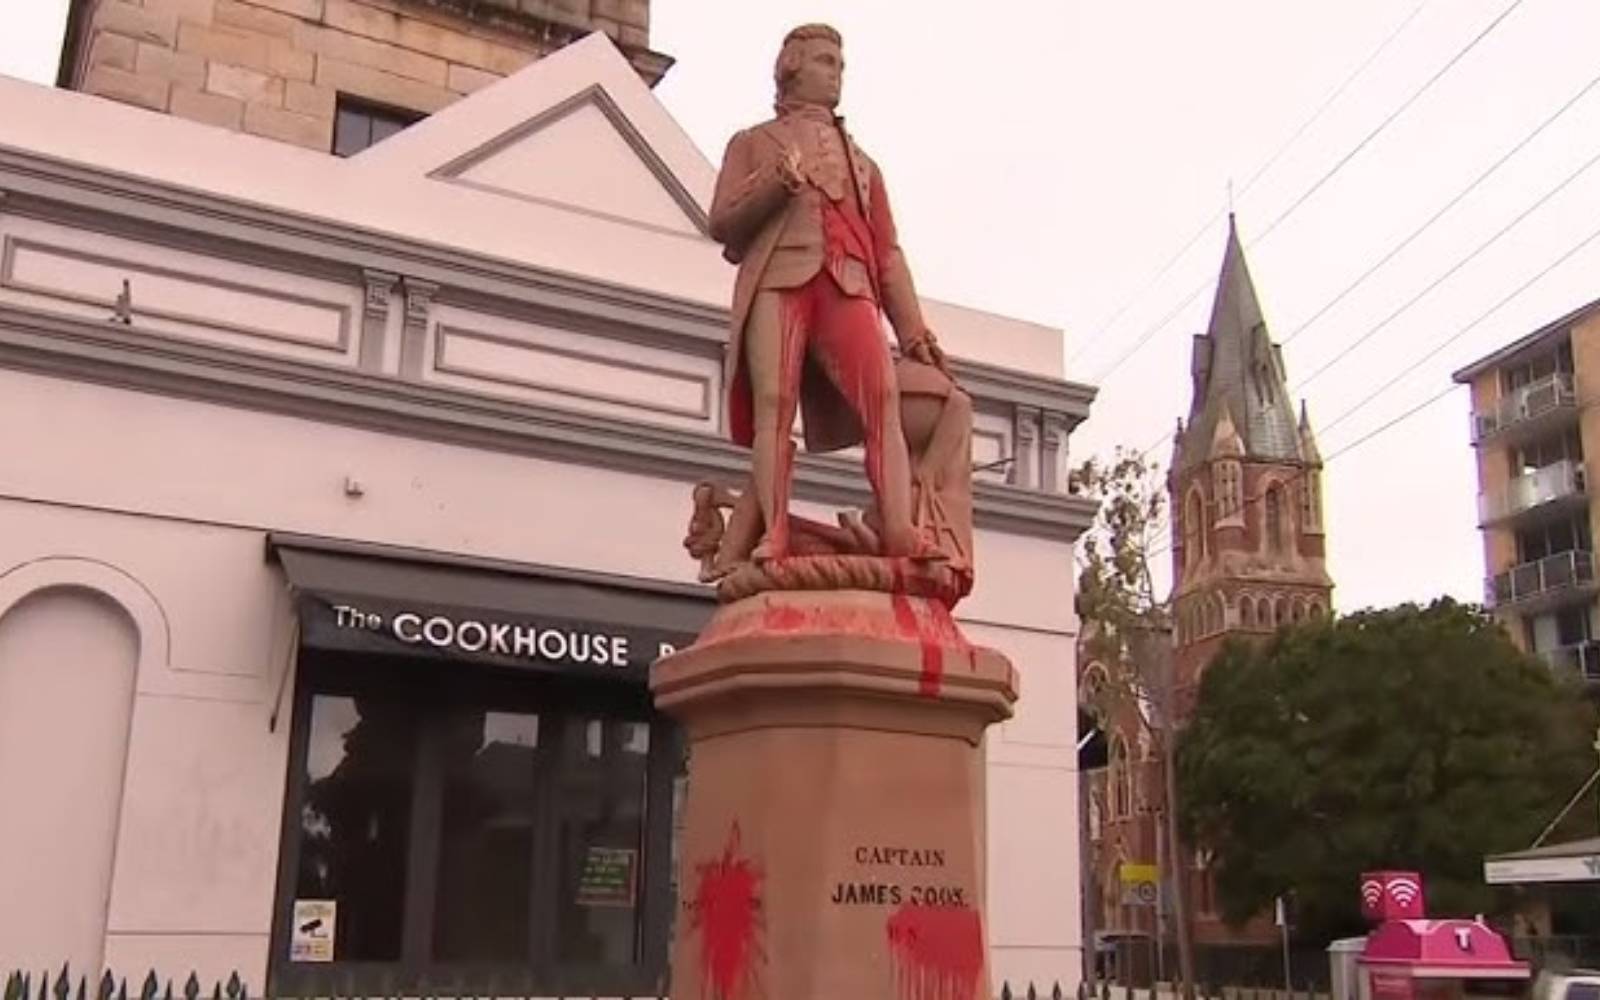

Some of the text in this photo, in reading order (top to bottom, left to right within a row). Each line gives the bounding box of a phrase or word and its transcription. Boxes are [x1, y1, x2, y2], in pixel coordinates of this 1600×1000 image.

[332, 605, 629, 667] The COOKHOUSE
[855, 846, 945, 867] CAPTAIN
[831, 883, 902, 905] JAMES
